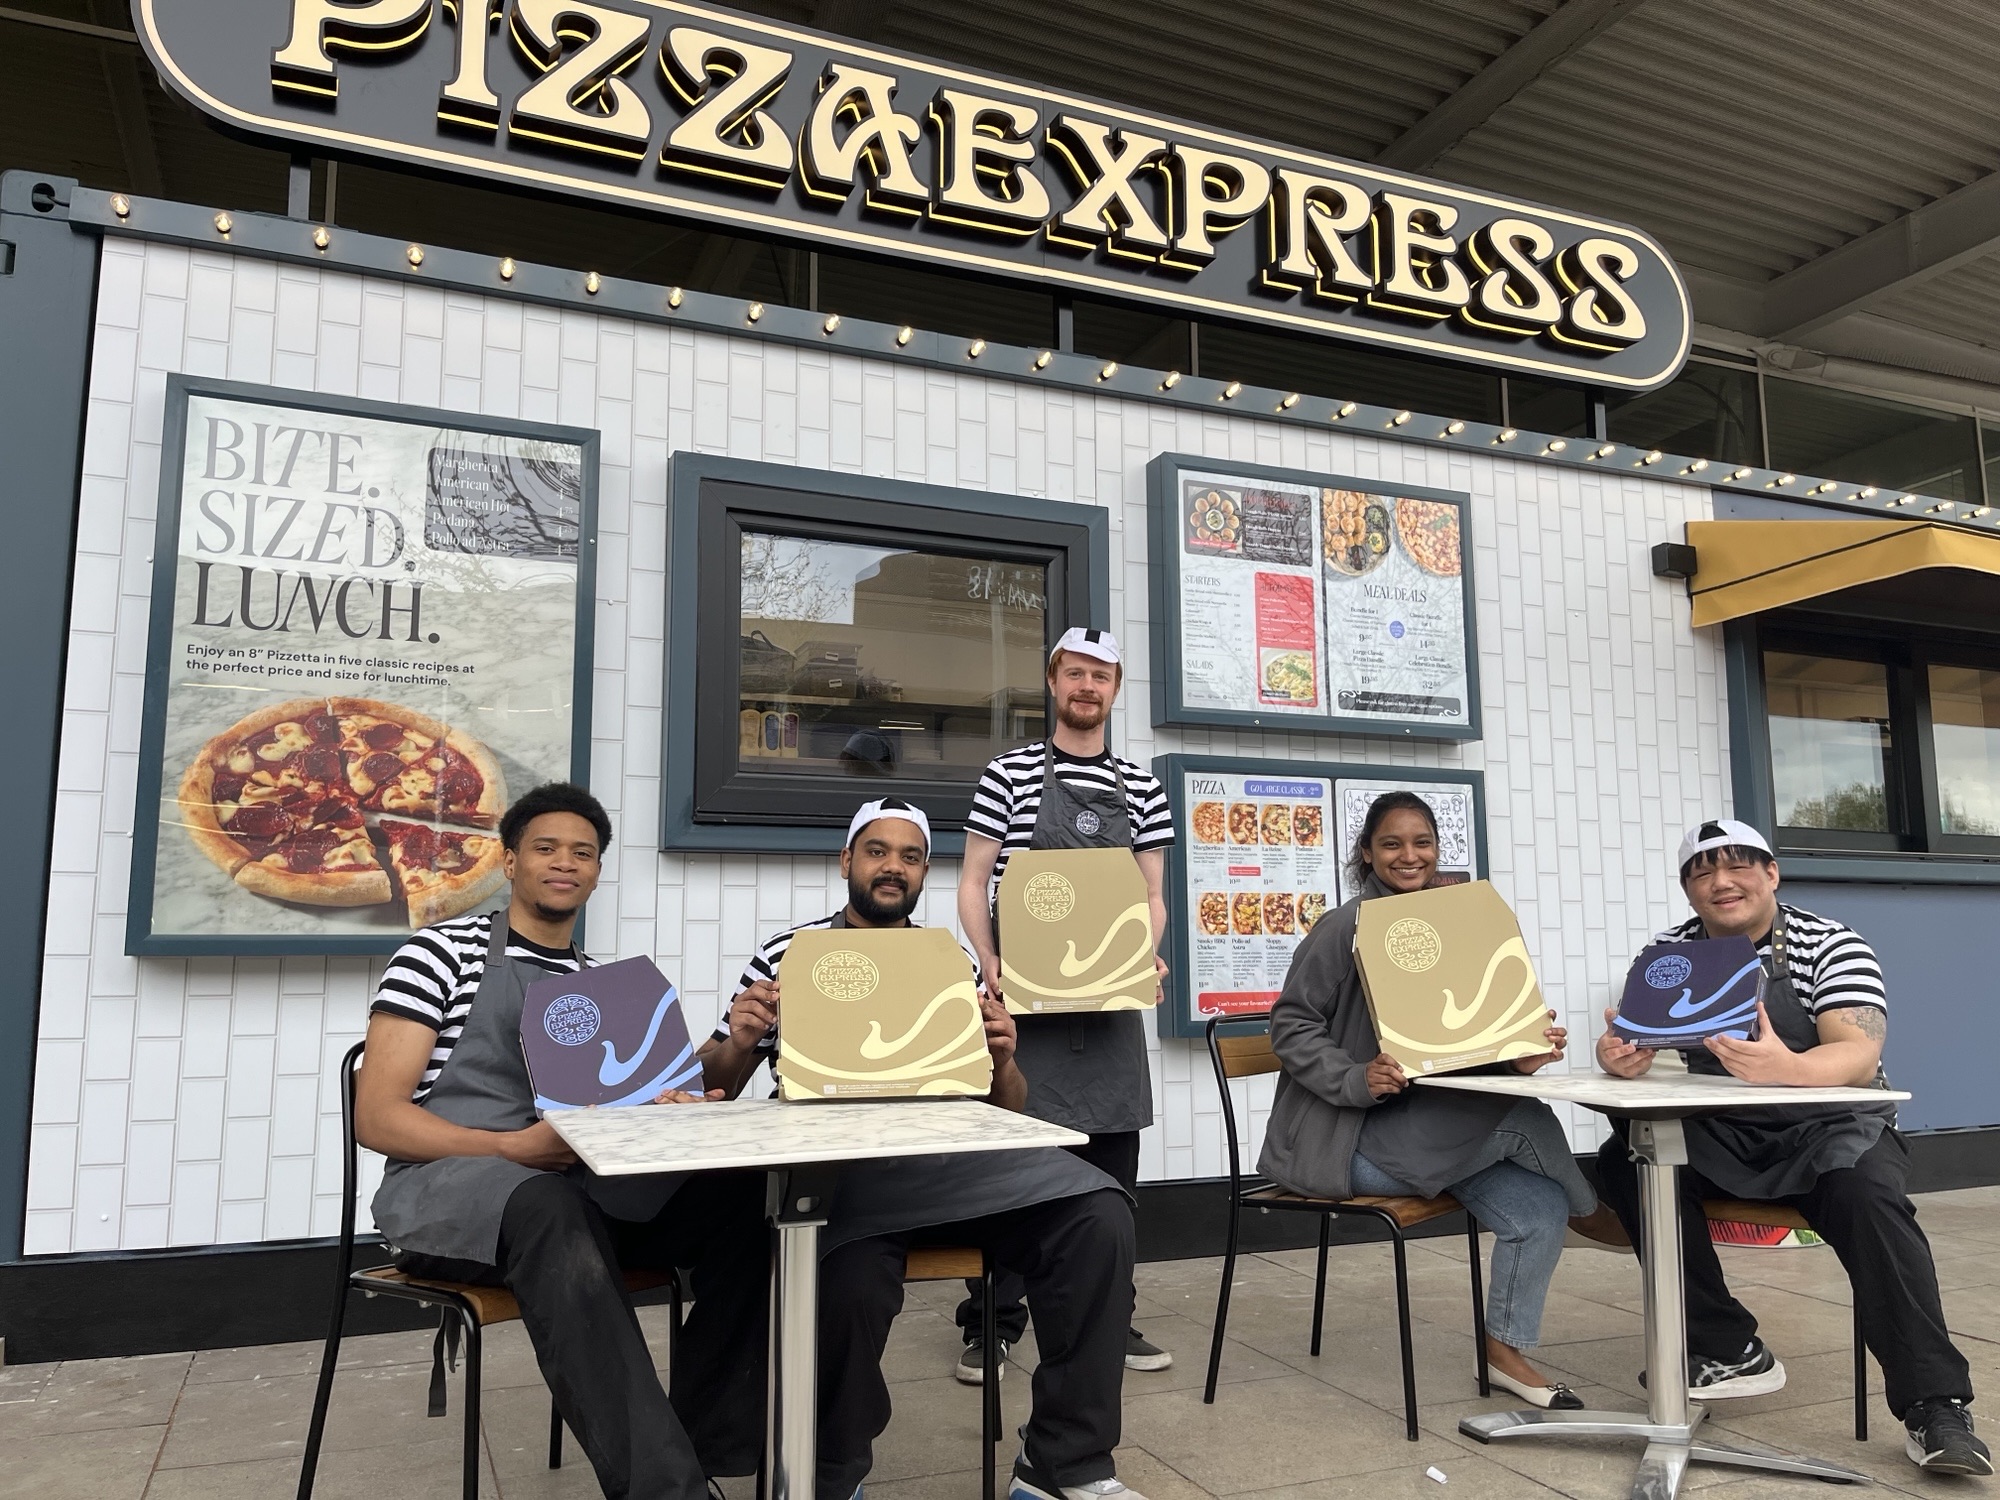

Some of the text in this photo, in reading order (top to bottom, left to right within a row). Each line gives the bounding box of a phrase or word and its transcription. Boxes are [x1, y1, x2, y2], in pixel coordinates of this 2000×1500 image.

[201, 416, 380, 498] BITE.
[435, 454, 498, 473] Margherita
[435, 475, 489, 491] American
[433, 495, 510, 512] American Hot
[433, 512, 475, 527] Padana
[196, 490, 416, 572] SIZED.
[432, 532, 460, 546] Pollo
[462, 536, 476, 548] ad
[479, 538, 509, 551] Astra
[1185, 575, 1221, 587] STARTERS
[1363, 584, 1427, 603] MEAL DEALS
[190, 561, 440, 644] LUNCH.
[187, 644, 224, 658] Enjoy
[228, 648, 245, 657] an
[267, 650, 320, 662] Pizzetta
[324, 654, 335, 664] in
[339, 655, 362, 665] five
[365, 658, 409, 669] classic
[413, 662, 459, 673] recipes
[462, 665, 475, 673] at
[1186, 660, 1214, 670] SALADS
[186, 660, 451, 686] the perfect price and size for lunchtime.
[1192, 780, 1226, 795] PIZZA
[1250, 784, 1260, 793] GO
[1260, 785, 1280, 793] LARGE
[1281, 786, 1306, 795] CLASSIC
[1391, 940, 1436, 954] EXPRESS
[1398, 935, 1425, 946] PIZZA
[551, 1013, 595, 1030] EXPRESS
[557, 1009, 585, 1021] PIZZA
